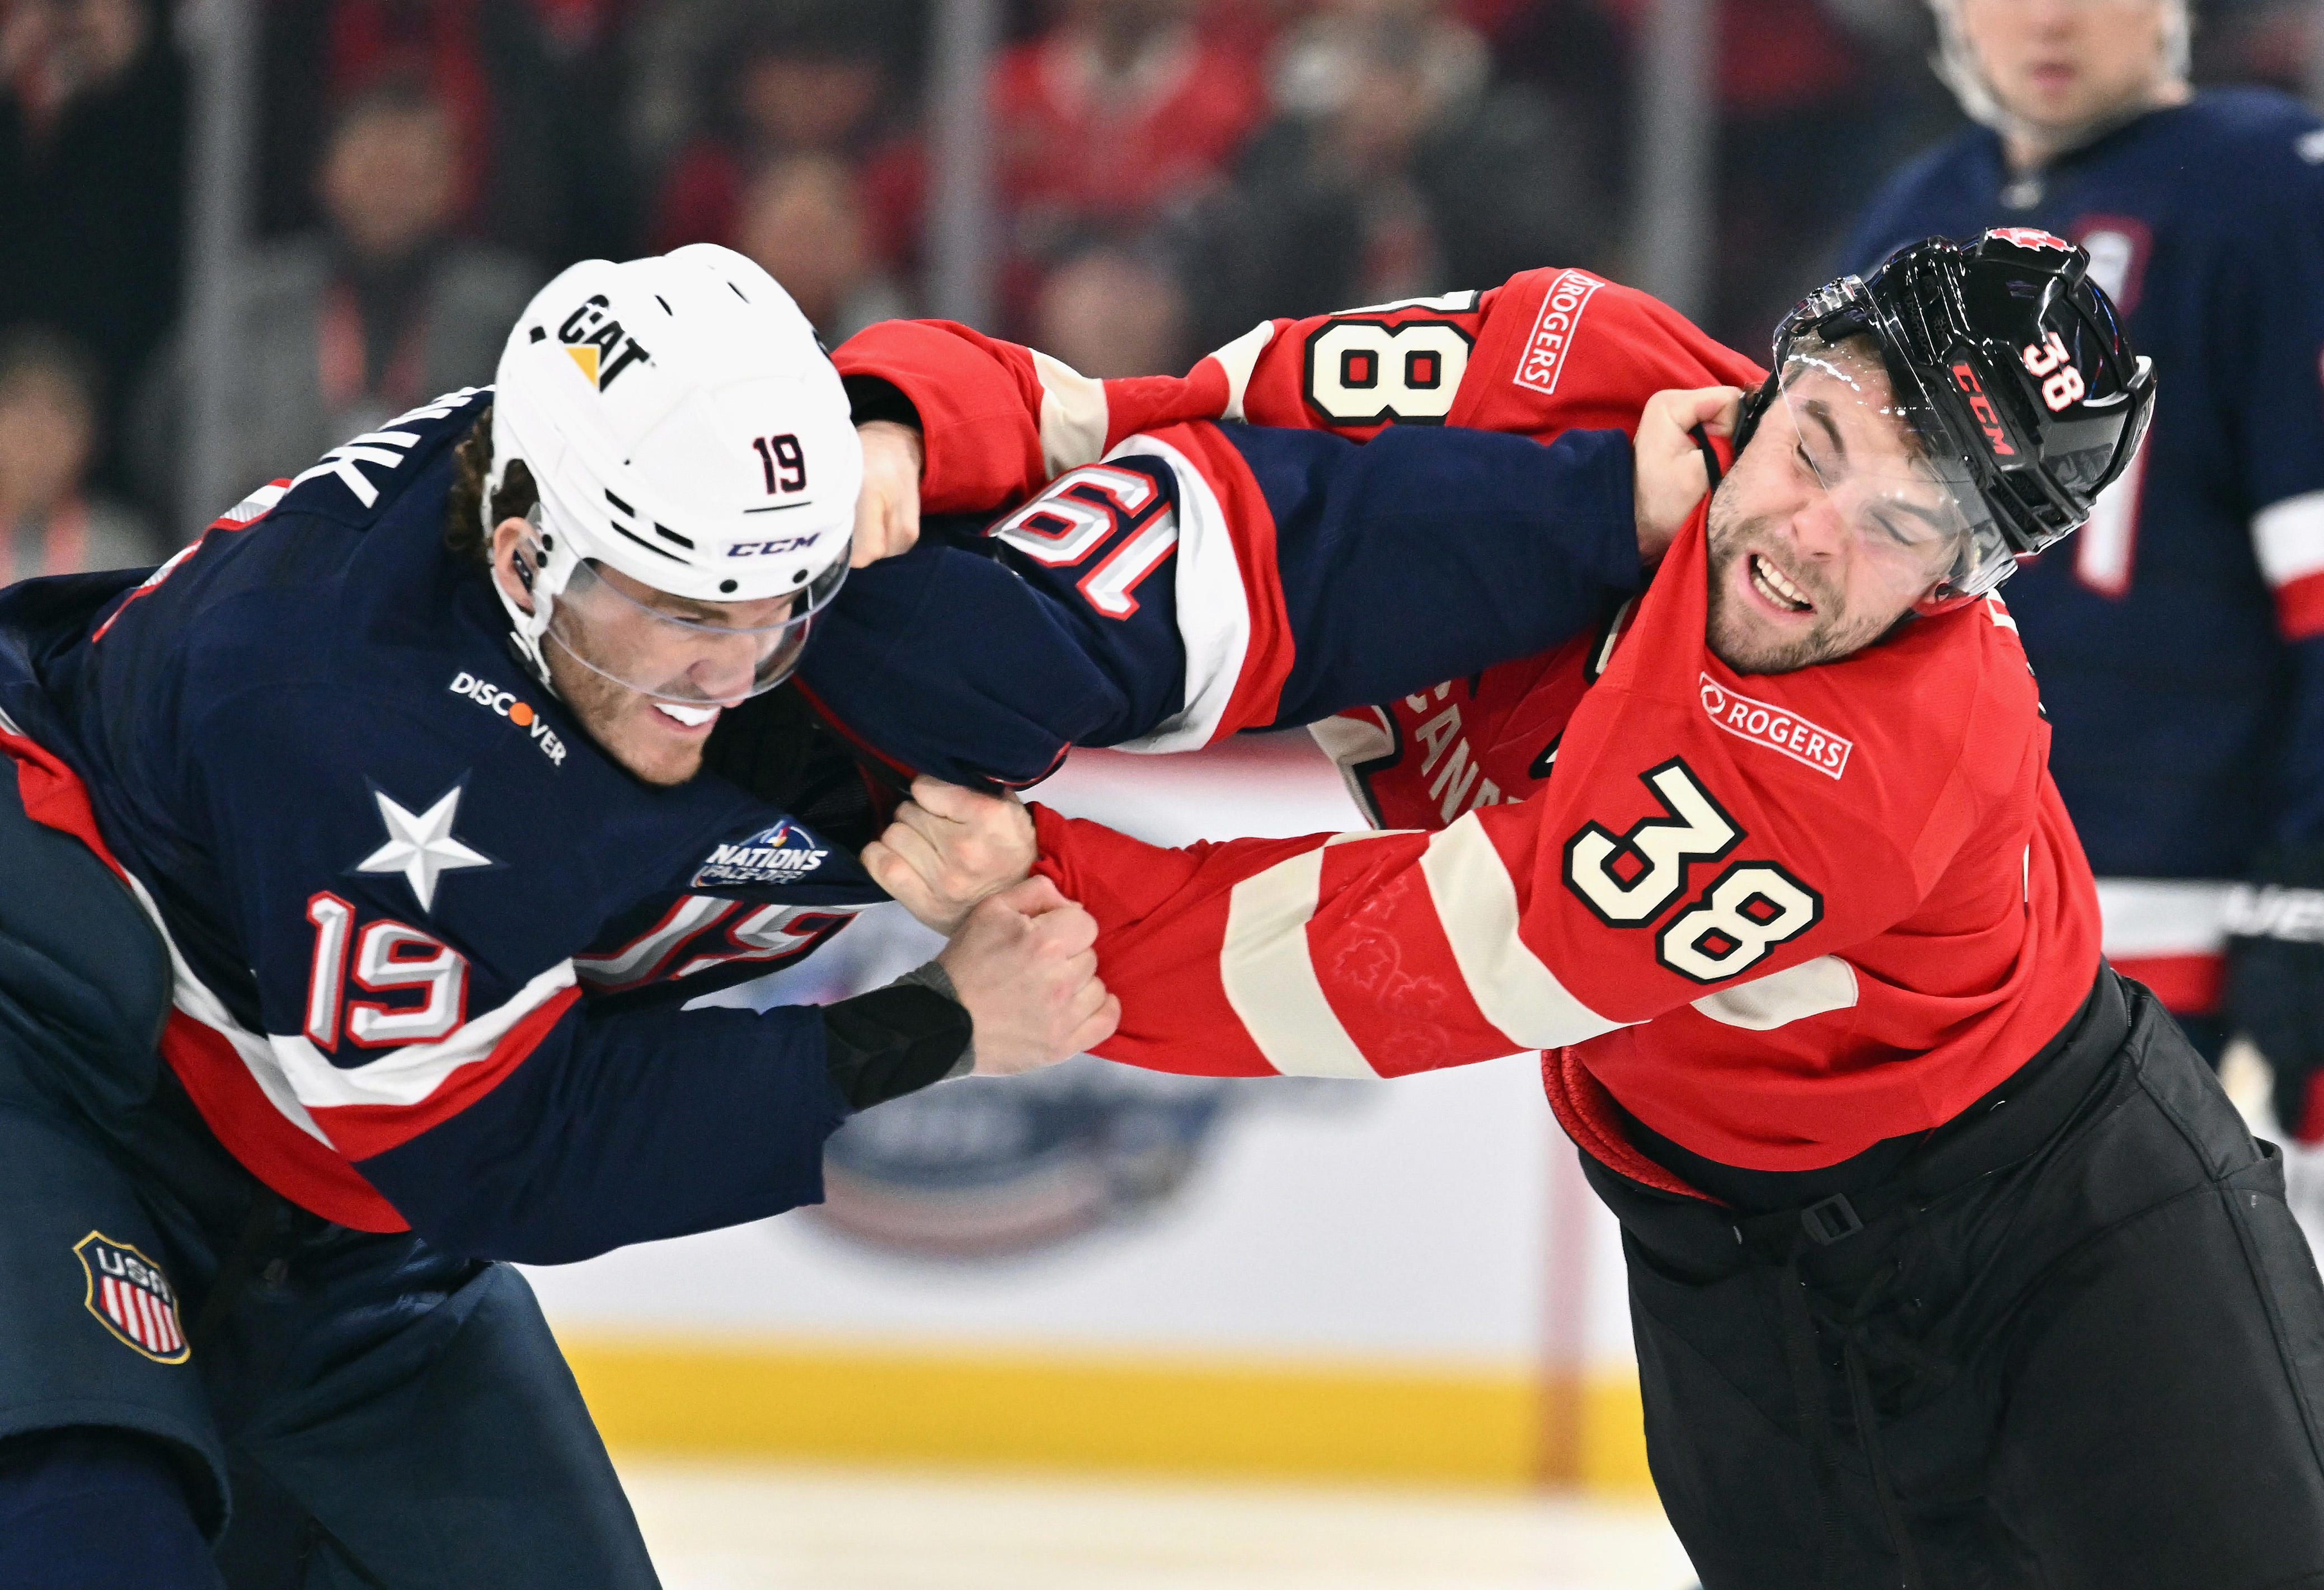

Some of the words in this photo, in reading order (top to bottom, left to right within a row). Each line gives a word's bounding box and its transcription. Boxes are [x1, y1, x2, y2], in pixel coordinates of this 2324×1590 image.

[558, 294, 650, 393] CAT
[1304, 289, 1483, 426] 8
[1524, 282, 1586, 384] ROGERS
[2022, 331, 2085, 412] 38
[1952, 363, 2015, 455] CCM
[753, 433, 807, 495] 19
[727, 532, 821, 557] CCM
[449, 672, 567, 766] DISCOVER
[1727, 702, 1843, 768] ROGERS
[705, 843, 829, 871] NATIONS
[1562, 755, 1824, 984] 38
[303, 890, 472, 1054] 19
[96, 1247, 171, 1303] USA
